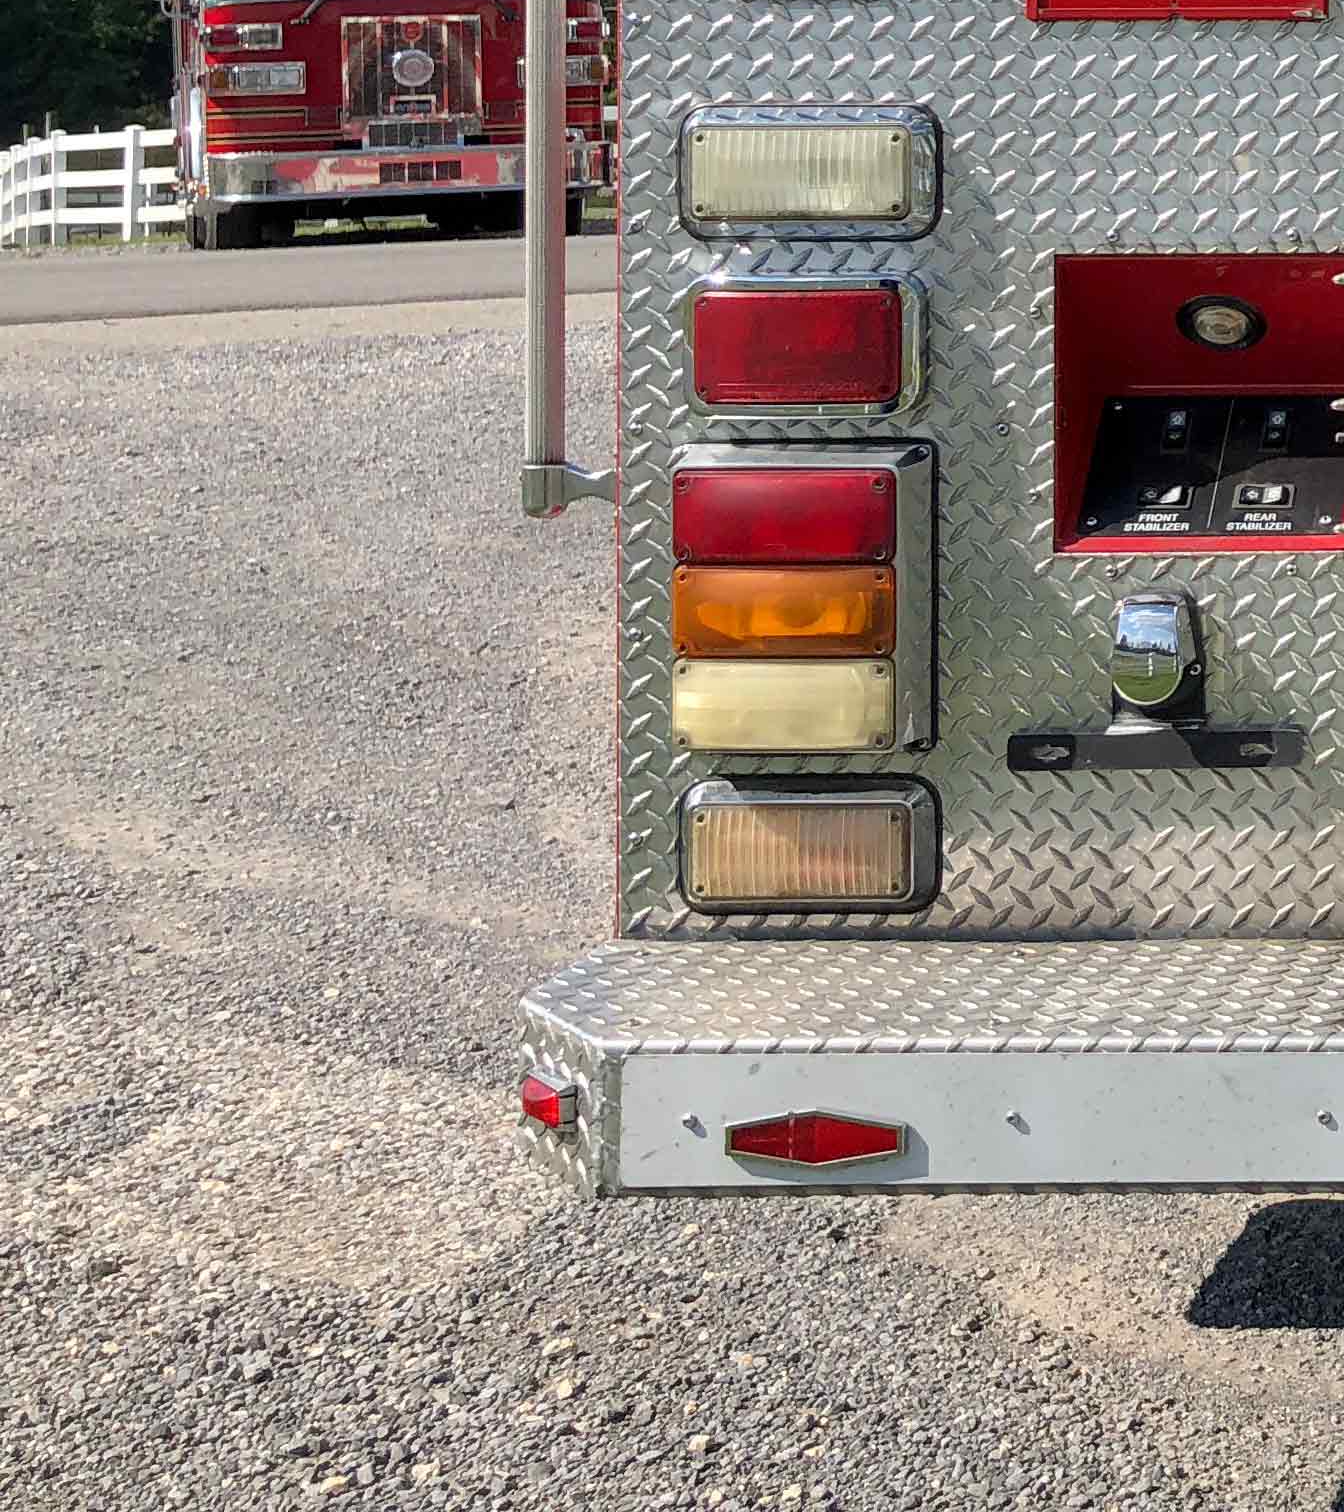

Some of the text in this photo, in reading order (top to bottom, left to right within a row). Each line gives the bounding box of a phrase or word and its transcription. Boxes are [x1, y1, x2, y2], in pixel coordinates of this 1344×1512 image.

[1138, 513, 1179, 522] FRONT
[1244, 513, 1277, 522] REAR
[1123, 522, 1190, 532] STABILIZER
[1226, 521, 1292, 531] STABILIZER
